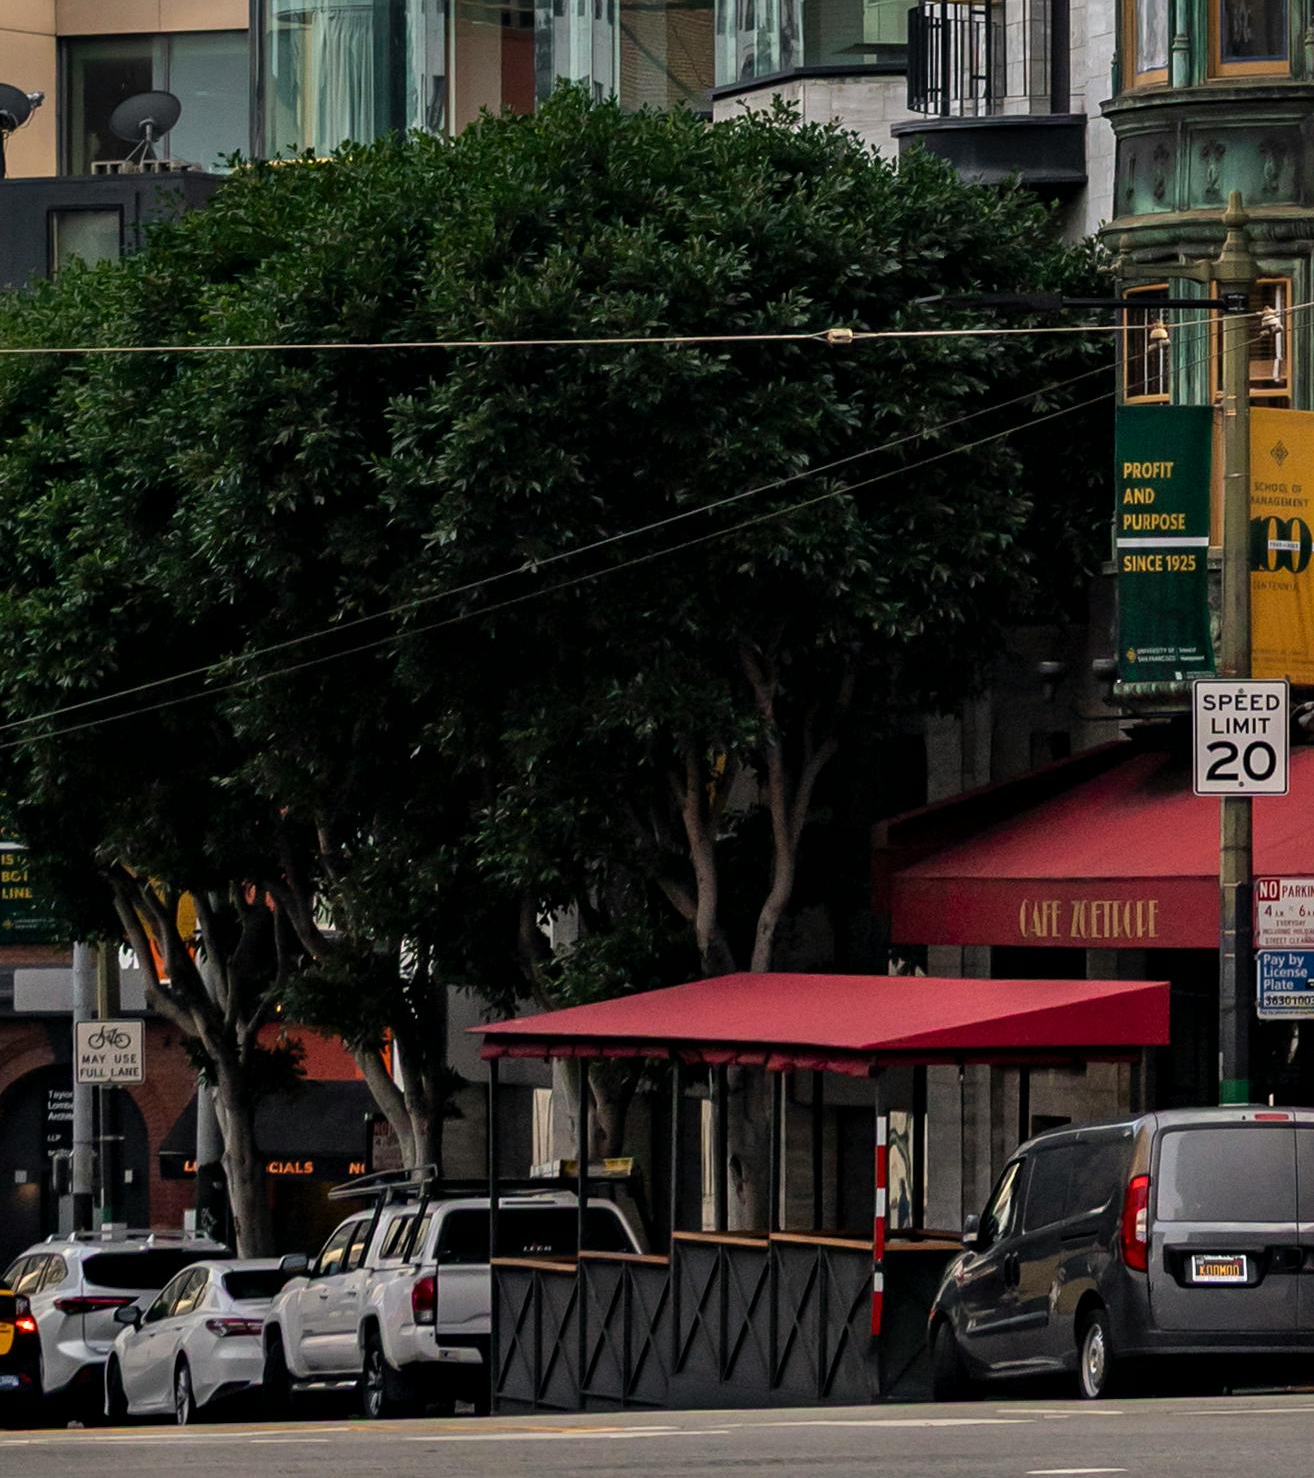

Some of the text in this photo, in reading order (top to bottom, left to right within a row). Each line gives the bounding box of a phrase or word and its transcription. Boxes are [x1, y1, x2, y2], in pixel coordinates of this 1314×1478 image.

[1123, 462, 1174, 479] PROFIT
[1255, 481, 1288, 493] SCHOOL
[1123, 488, 1156, 505] AND
[1123, 514, 1186, 531] PURPOSE
[1123, 555, 1197, 572] SINCE 1925
[1203, 694, 1280, 711] SPEED
[1211, 718, 1271, 734] LIMIT
[1206, 741, 1277, 781] 20
[1260, 881, 1278, 898] NO
[1019, 898, 1160, 939] CAFE ZOETROPE
[1264, 905, 1272, 917] 4
[1299, 904, 1305, 917] 6
[1263, 953, 1304, 967] Pay by
[1263, 966, 1308, 978] License
[1263, 978, 1294, 990] Plate
[82, 1054, 137, 1064] MAY USE
[80, 1067, 139, 1078] FULL LANE
[266, 1161, 314, 1174] CIALS
